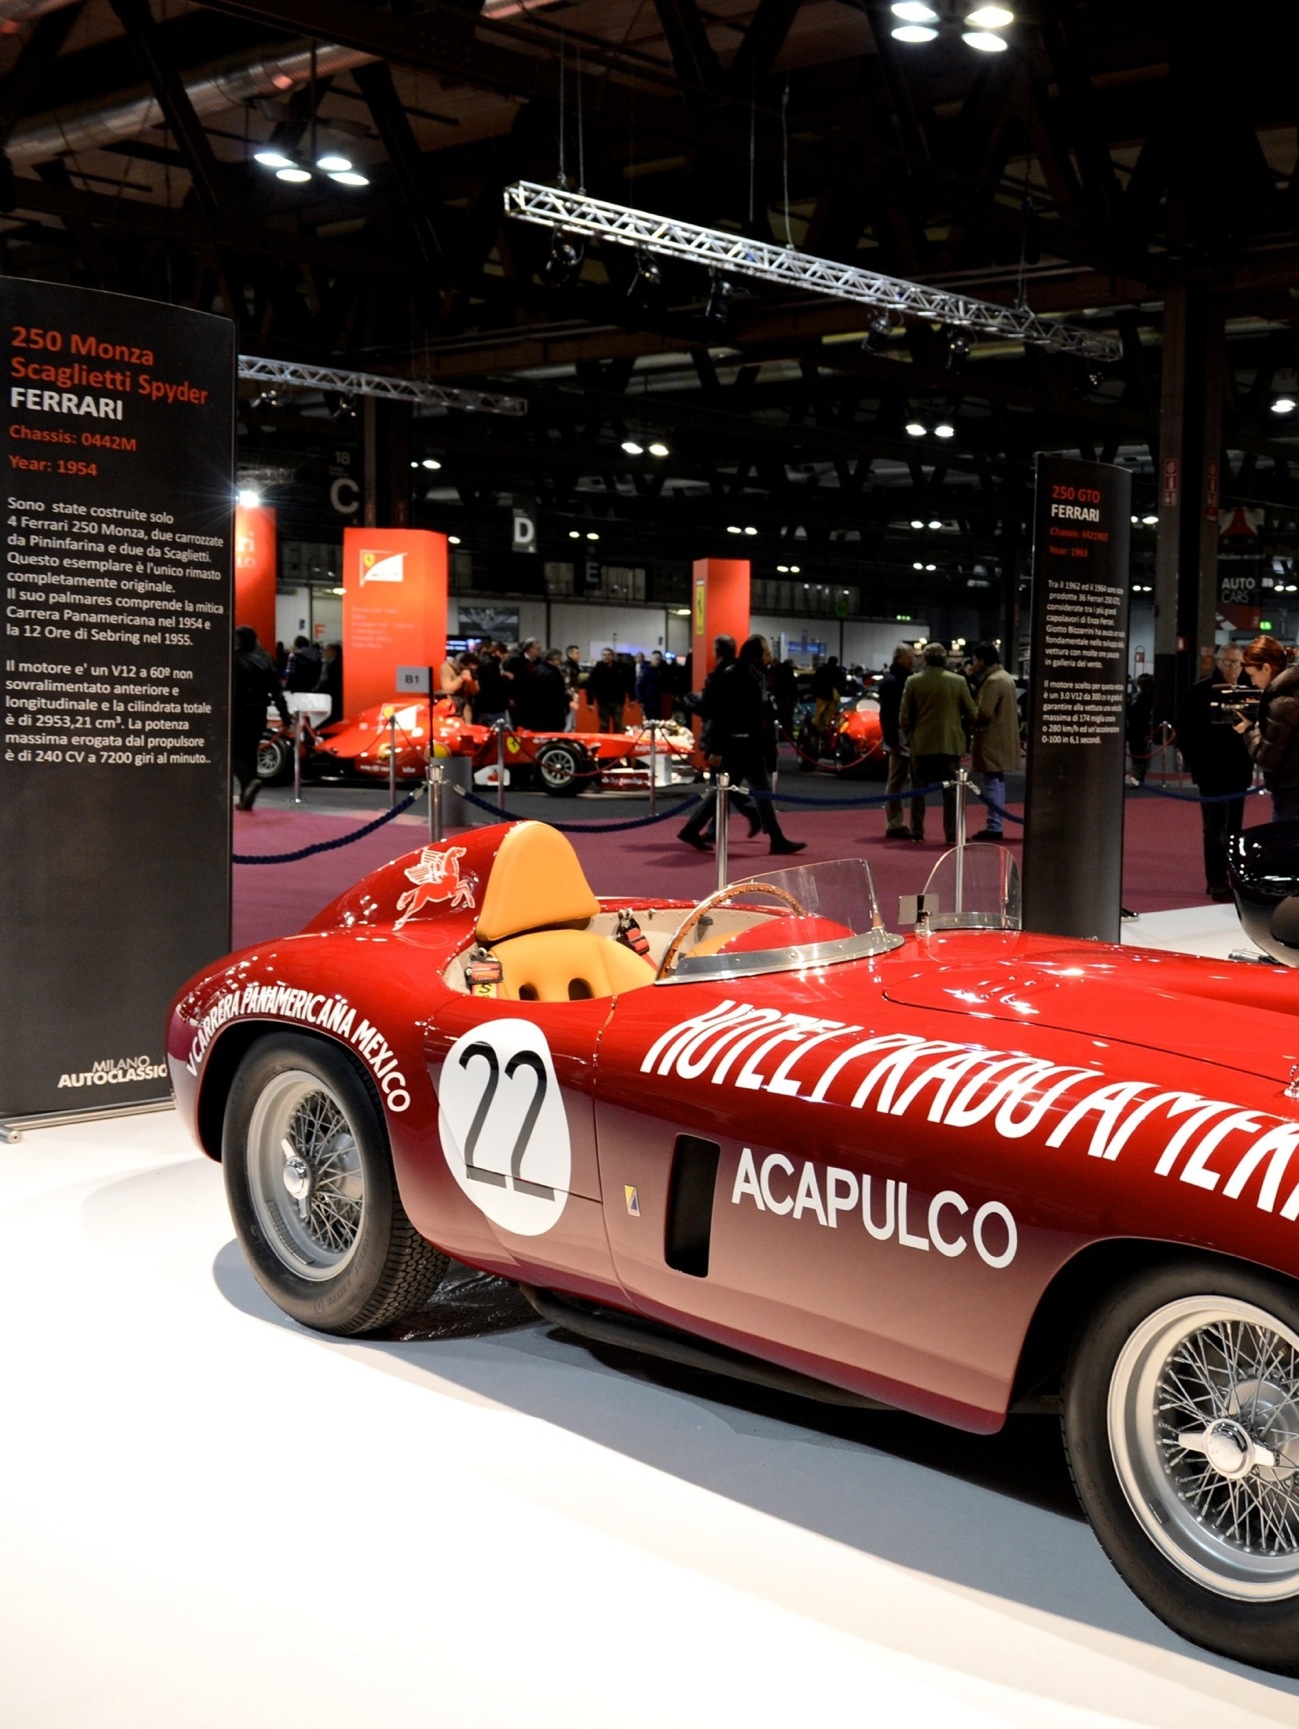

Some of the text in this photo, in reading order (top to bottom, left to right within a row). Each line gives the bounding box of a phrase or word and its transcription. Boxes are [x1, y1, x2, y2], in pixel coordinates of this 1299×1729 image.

[11, 326, 154, 365] 250 Monza
[10, 357, 208, 405] Scaglietti Spyder
[11, 387, 123, 421] FERRARI
[9, 424, 137, 451] Chassis: 0442M
[9, 455, 98, 476] Year: 1954
[335, 451, 350, 466] 18
[330, 478, 360, 514] C
[1052, 485, 1100, 503] 250 GTO
[7, 496, 174, 524] Sono state costruite solo
[1051, 504, 1100, 522] FERRARI
[7, 515, 18, 527] 4
[21, 516, 68, 531] Ferrari
[72, 520, 98, 534] 250
[101, 523, 149, 540] Monza,
[150, 528, 174, 541] due
[175, 533, 224, 547] carrozzate
[514, 517, 534, 543] D
[7, 533, 211, 563] da Pininfarina e due da Scaglietti.
[6, 551, 60, 567] Questo
[62, 558, 134, 573] esemplare
[135, 561, 145, 574] è
[185, 566, 221, 580] rimasto
[6, 572, 176, 594] completamente originale.
[1221, 577, 1256, 589] AUTO
[6, 587, 224, 614] Il suo palmares comprende la mitica
[1221, 590, 1249, 603] CARS
[6, 605, 211, 630] Carrera Panamericana nel 1954 e
[1046, 603, 1083, 612] considerate
[1046, 614, 1079, 623] capolavori
[1046, 624, 1067, 633] Giotto
[6, 623, 193, 646] la 12 Ore di Sebring nel 1955.
[1046, 635, 1088, 646] fondamentale
[6, 659, 15, 672] Il
[18, 662, 72, 675] motore
[90, 666, 109, 676] un
[111, 665, 137, 678] V12
[139, 668, 148, 678] a
[172, 670, 193, 679] non
[1052, 659, 1076, 668] galleria
[5, 679, 180, 696] sovralimentato anteriore e
[405, 674, 419, 684] B1
[1049, 681, 1074, 689] motore
[5, 695, 212, 714] longitudinale e la cilindrata totale
[1043, 703, 1072, 712] garantire
[4, 713, 16, 726] è
[18, 713, 32, 726] di
[35, 714, 92, 730] 2953,21
[128, 718, 143, 730] La
[144, 719, 190, 732] potenza
[5, 732, 205, 749] massima erogata dal propulsore
[4, 749, 15, 762] è
[17, 749, 32, 762] di
[35, 750, 63, 763] 240
[64, 750, 86, 763] CV
[87, 753, 97, 764] a
[99, 751, 133, 764] 7200
[134, 752, 155, 767] giri
[156, 752, 168, 764] al
[192, 990, 240, 1063] CARRERA
[350, 1019, 411, 1112] MEXICO
[640, 999, 863, 1097] HOTEL
[92, 1055, 150, 1073] MILANO
[57, 1064, 168, 1088] AUTOCLASSIC
[458, 1040, 555, 1203] 22
[731, 1147, 1018, 1269] ACAPULCO
